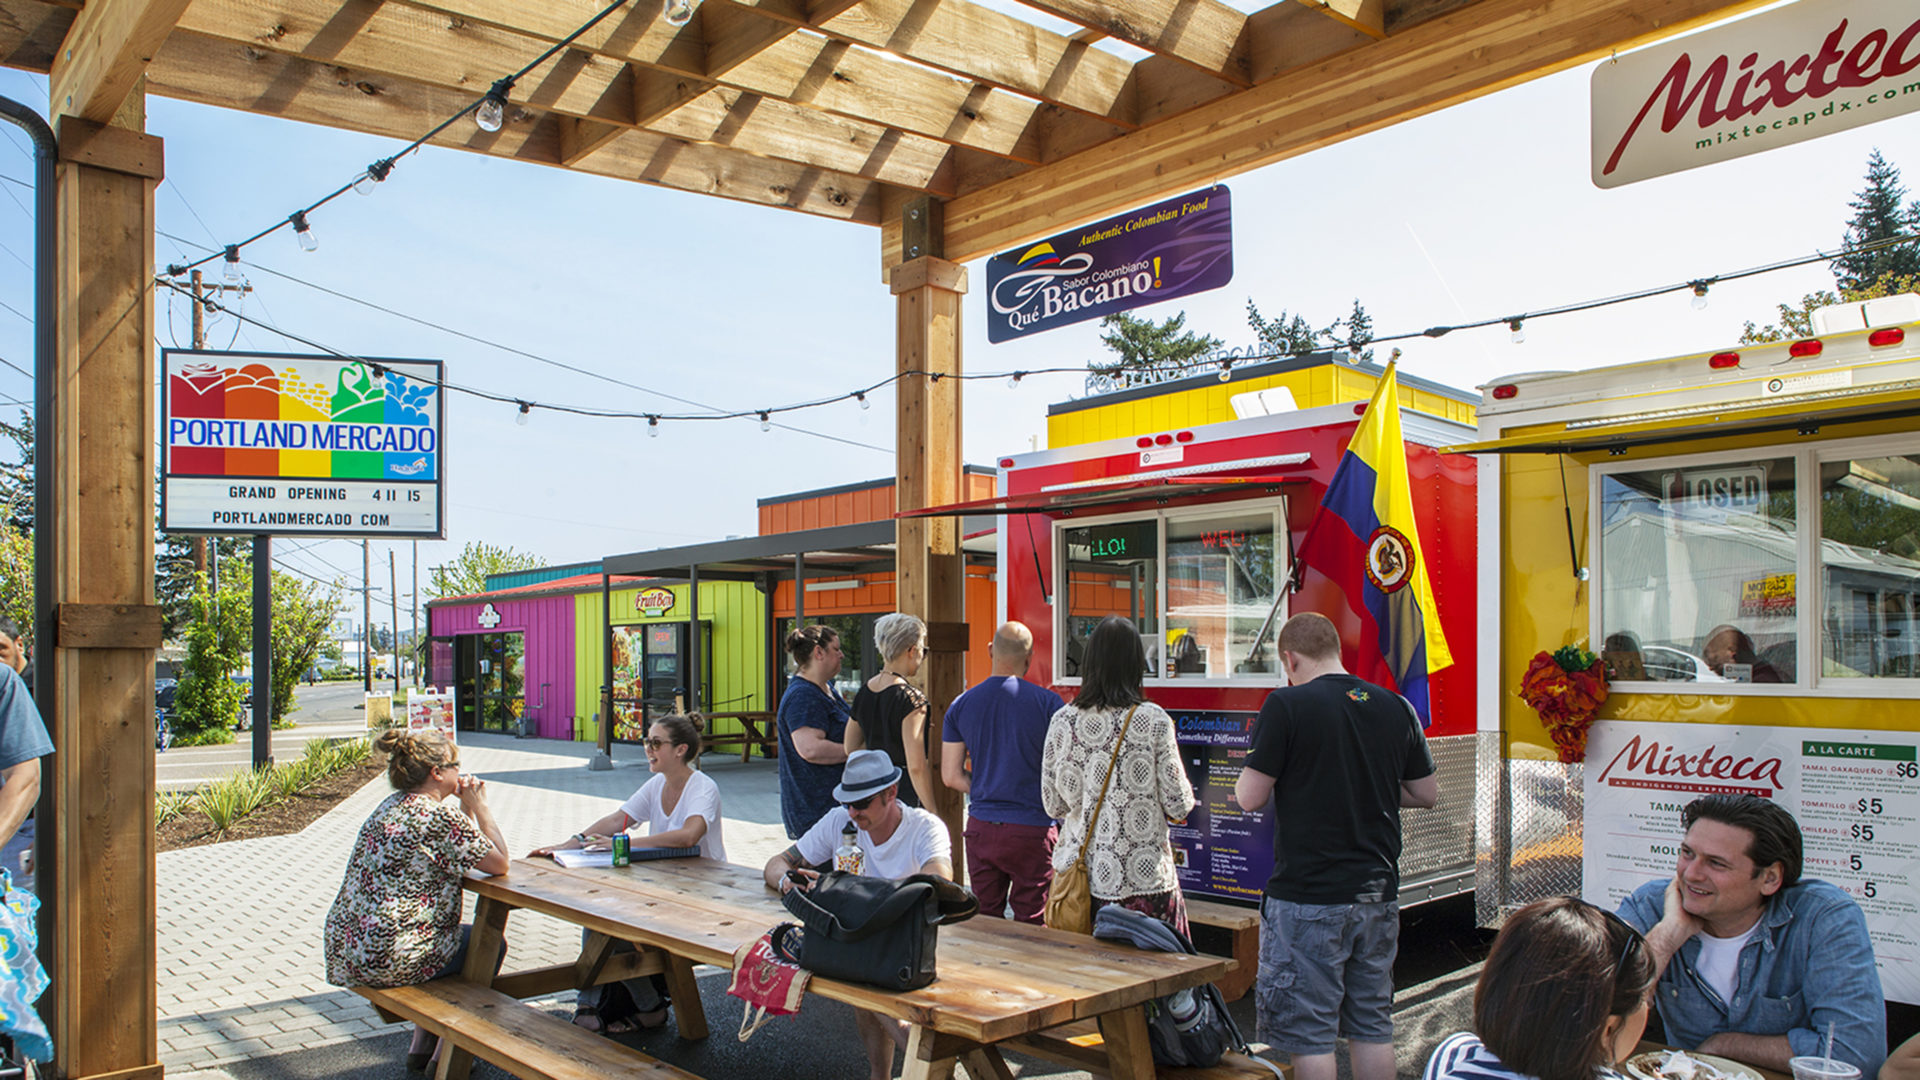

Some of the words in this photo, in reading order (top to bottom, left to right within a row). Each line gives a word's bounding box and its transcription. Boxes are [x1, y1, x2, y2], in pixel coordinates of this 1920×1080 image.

[1602, 18, 1920, 175] Mixtec
[1695, 83, 1920, 149] mixtecapdx.com
[1078, 225, 1123, 247] Authentic
[1125, 208, 1178, 233] Colombian
[1181, 197, 1209, 216] Food
[1062, 276, 1090, 291] Sabor
[1091, 260, 1150, 282] Colombiano
[1008, 306, 1040, 331] Qué
[1042, 256, 1162, 319] Bacano!
[170, 419, 307, 449] PORTLAND
[312, 423, 436, 452] MERCADO
[229, 486, 276, 500] GRAND
[288, 488, 347, 500] OPENING
[372, 489, 381, 501] 4
[407, 490, 421, 502] 15
[213, 511, 352, 526] PORTLANDMERCADO
[361, 514, 390, 527] COM
[655, 632, 669, 641] OPEN
[1178, 716, 1241, 732] Colombian
[1177, 732, 1212, 743] Something
[1213, 733, 1250, 744] Different!
[1808, 745, 1817, 753] A
[1821, 746, 1835, 754] LA
[1838, 747, 1876, 756] CARTE
[1598, 735, 1784, 790] Mixteca
[1801, 764, 1828, 772] TAMAL
[1831, 766, 1883, 775] OAXAQUEÑO
[1896, 761, 1919, 778] $6
[1631, 781, 1693, 791] INDIGENOUS
[1698, 786, 1763, 796] EXPERIENCE
[1649, 802, 1684, 813] TAMA
[1801, 800, 1846, 809] TOMATILLO
[1801, 826, 1838, 835] CHILEAJO
[1851, 824, 1874, 840] $5
[1803, 857, 1837, 866] OPEYE'S
[1850, 855, 1862, 871] 5
[1864, 881, 1877, 898] 5
